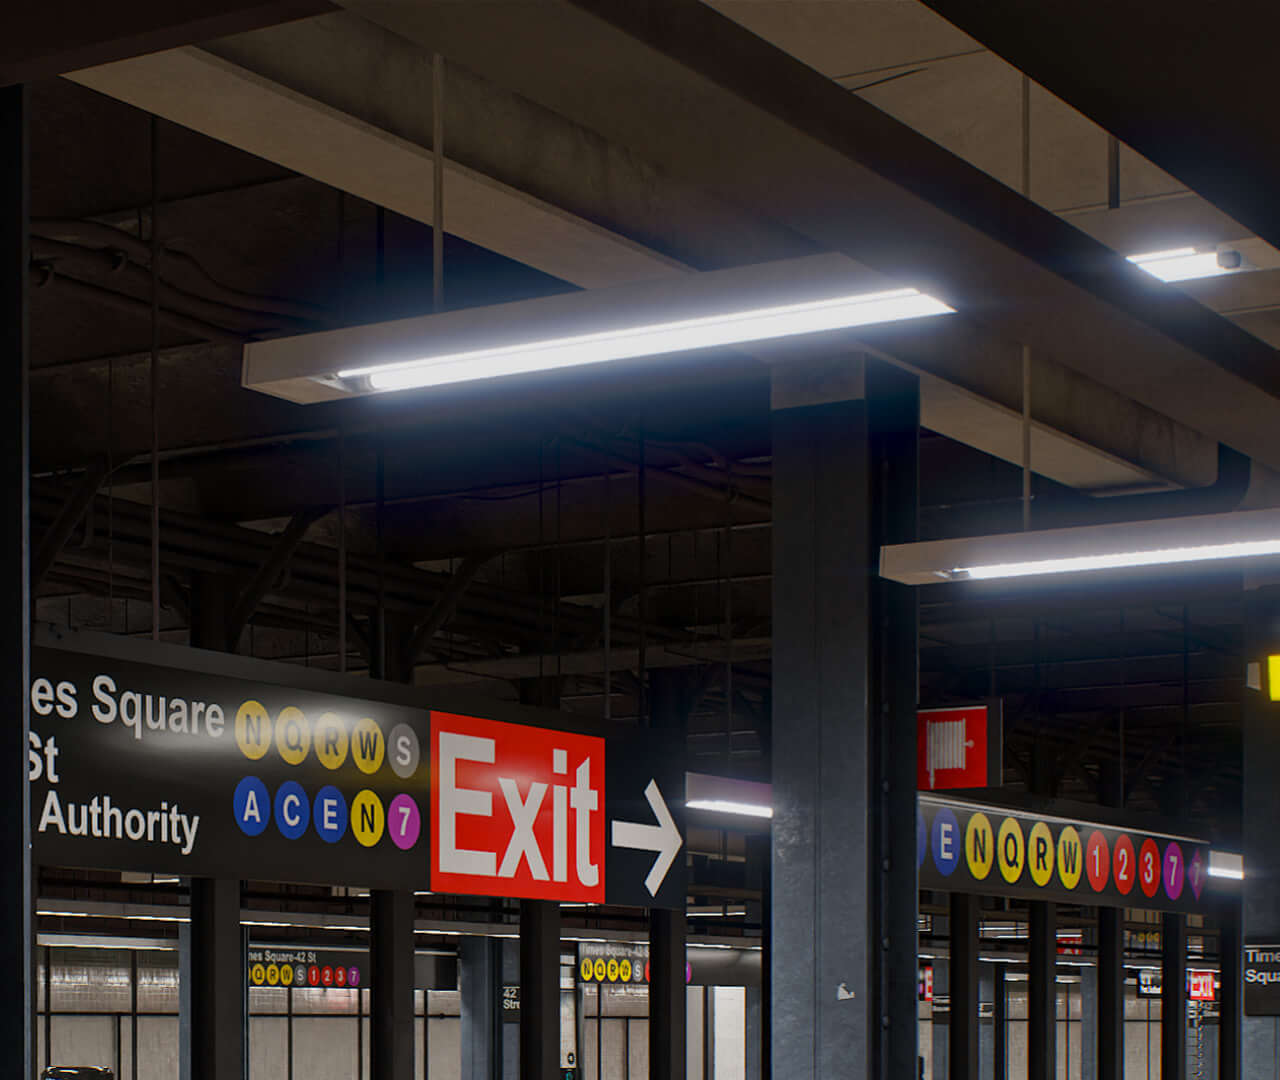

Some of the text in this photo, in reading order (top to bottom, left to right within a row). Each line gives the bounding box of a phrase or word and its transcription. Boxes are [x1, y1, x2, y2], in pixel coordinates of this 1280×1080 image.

[91, 674, 225, 740] Square
[38, 790, 200, 856] Authority
[438, 730, 600, 888] Exit
[503, 989, 517, 998] 42
